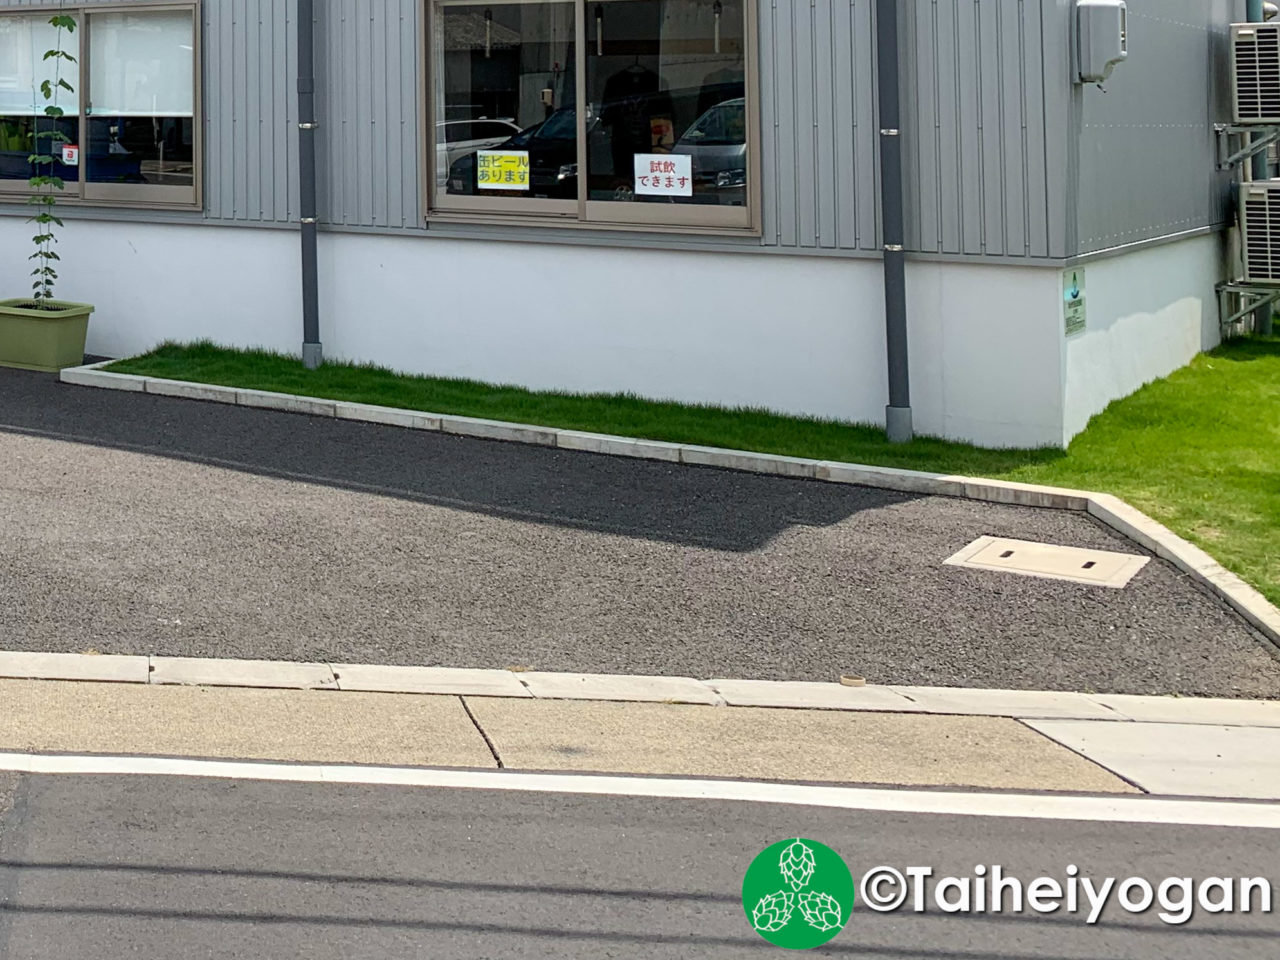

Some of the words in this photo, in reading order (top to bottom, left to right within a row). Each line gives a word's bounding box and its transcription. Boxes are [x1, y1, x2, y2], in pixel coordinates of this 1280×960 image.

[479, 154, 529, 168] 缶ビール
[649, 160, 676, 174] 試飲
[478, 169, 529, 183] あります
[637, 175, 689, 189] できます
